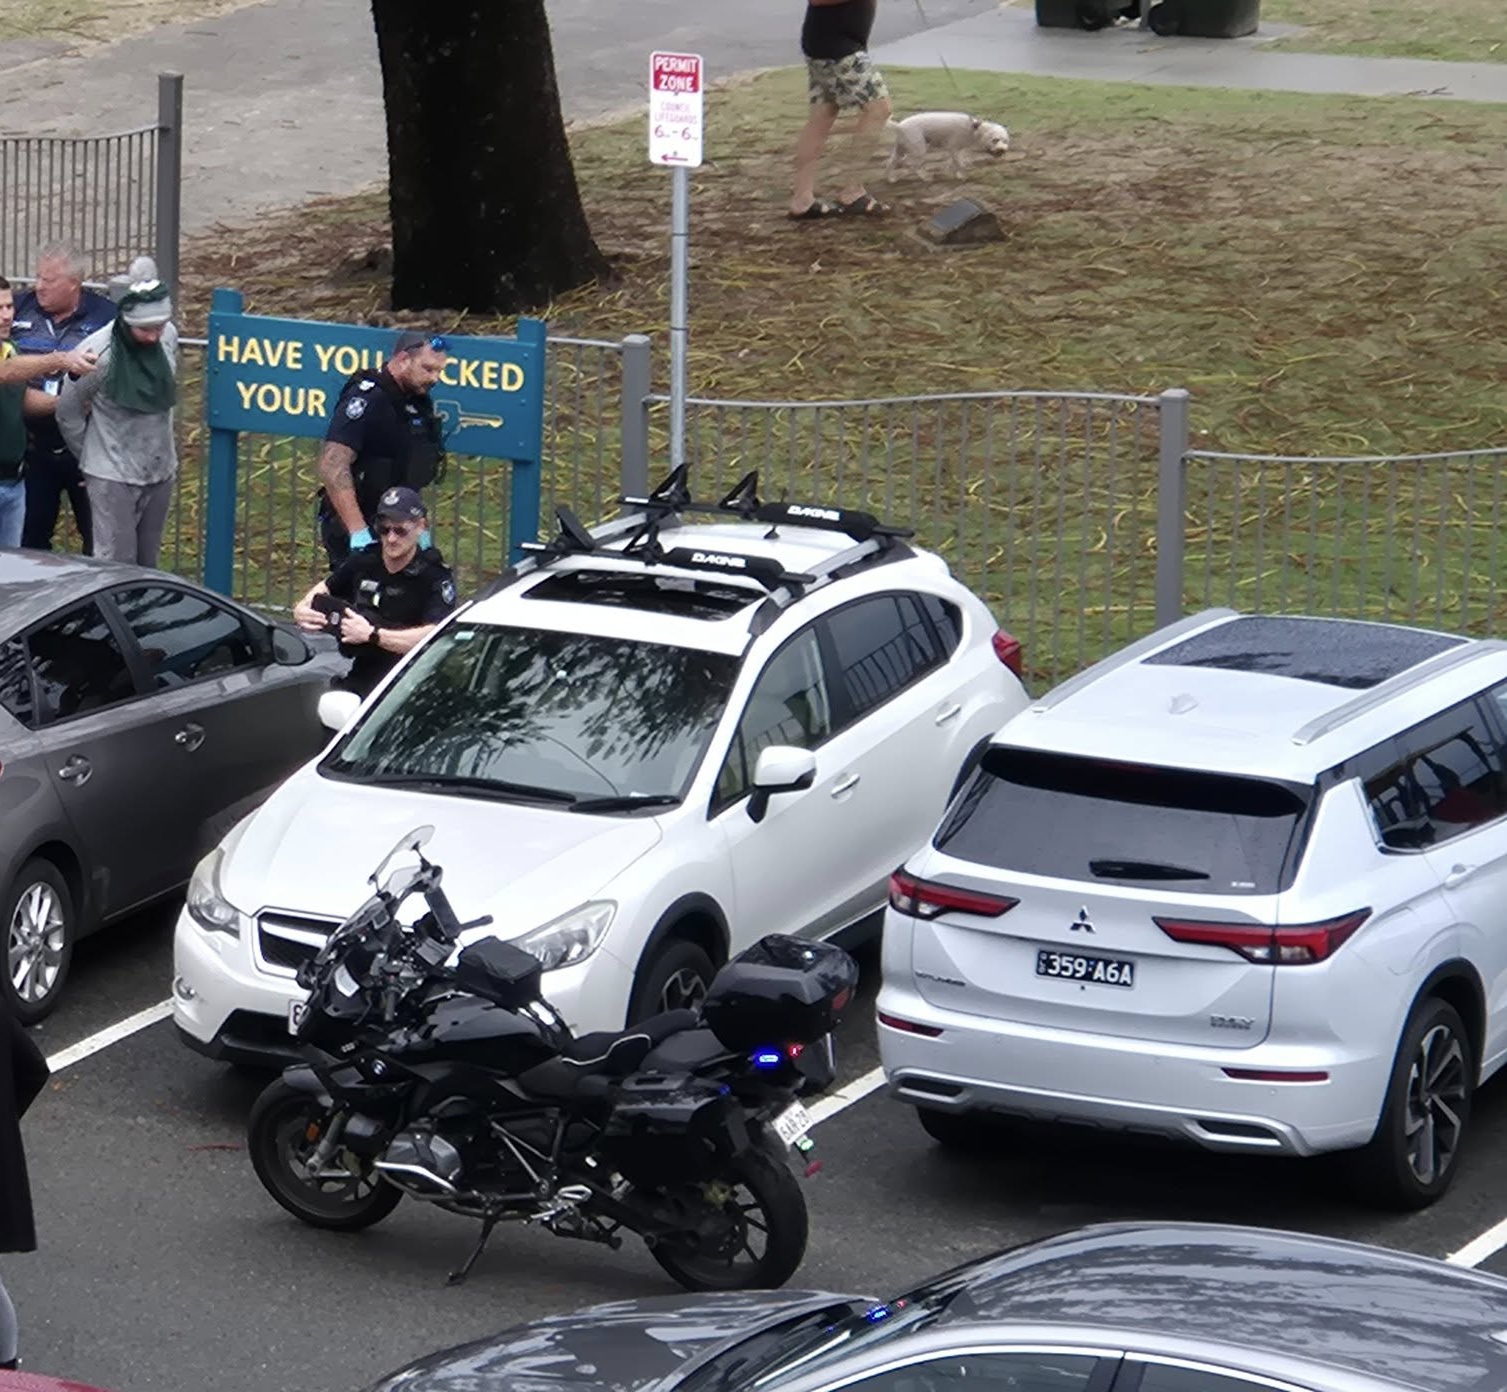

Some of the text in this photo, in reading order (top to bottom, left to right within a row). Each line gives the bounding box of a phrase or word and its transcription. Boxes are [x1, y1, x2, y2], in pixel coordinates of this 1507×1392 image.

[654, 56, 698, 73] PERMIT
[659, 74, 694, 92] ZONE
[218, 335, 303, 369] HAVE
[439, 357, 525, 392] CKED
[237, 381, 327, 418] YOUR
